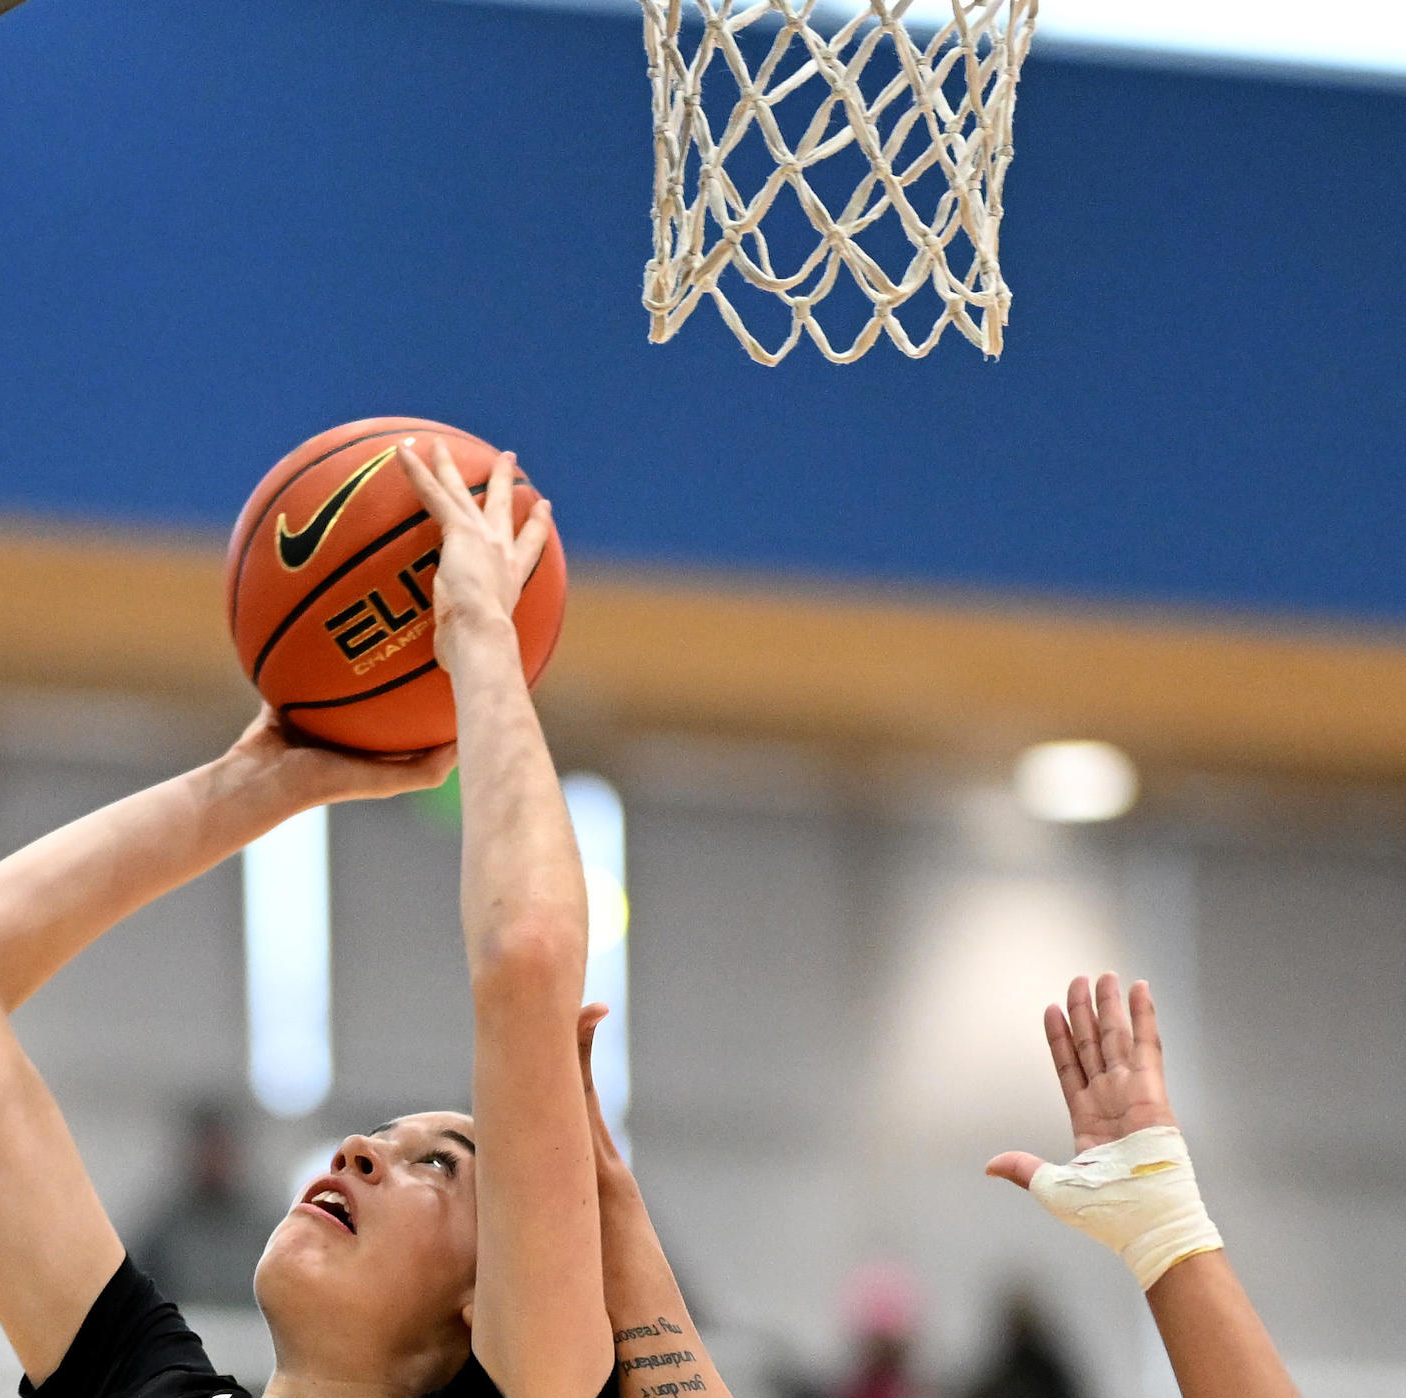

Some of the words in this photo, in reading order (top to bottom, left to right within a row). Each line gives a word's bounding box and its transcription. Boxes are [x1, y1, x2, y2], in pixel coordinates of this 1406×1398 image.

[657, 1316, 683, 1335] my
[621, 1350, 697, 1377] understand
[679, 1373, 707, 1392] you
